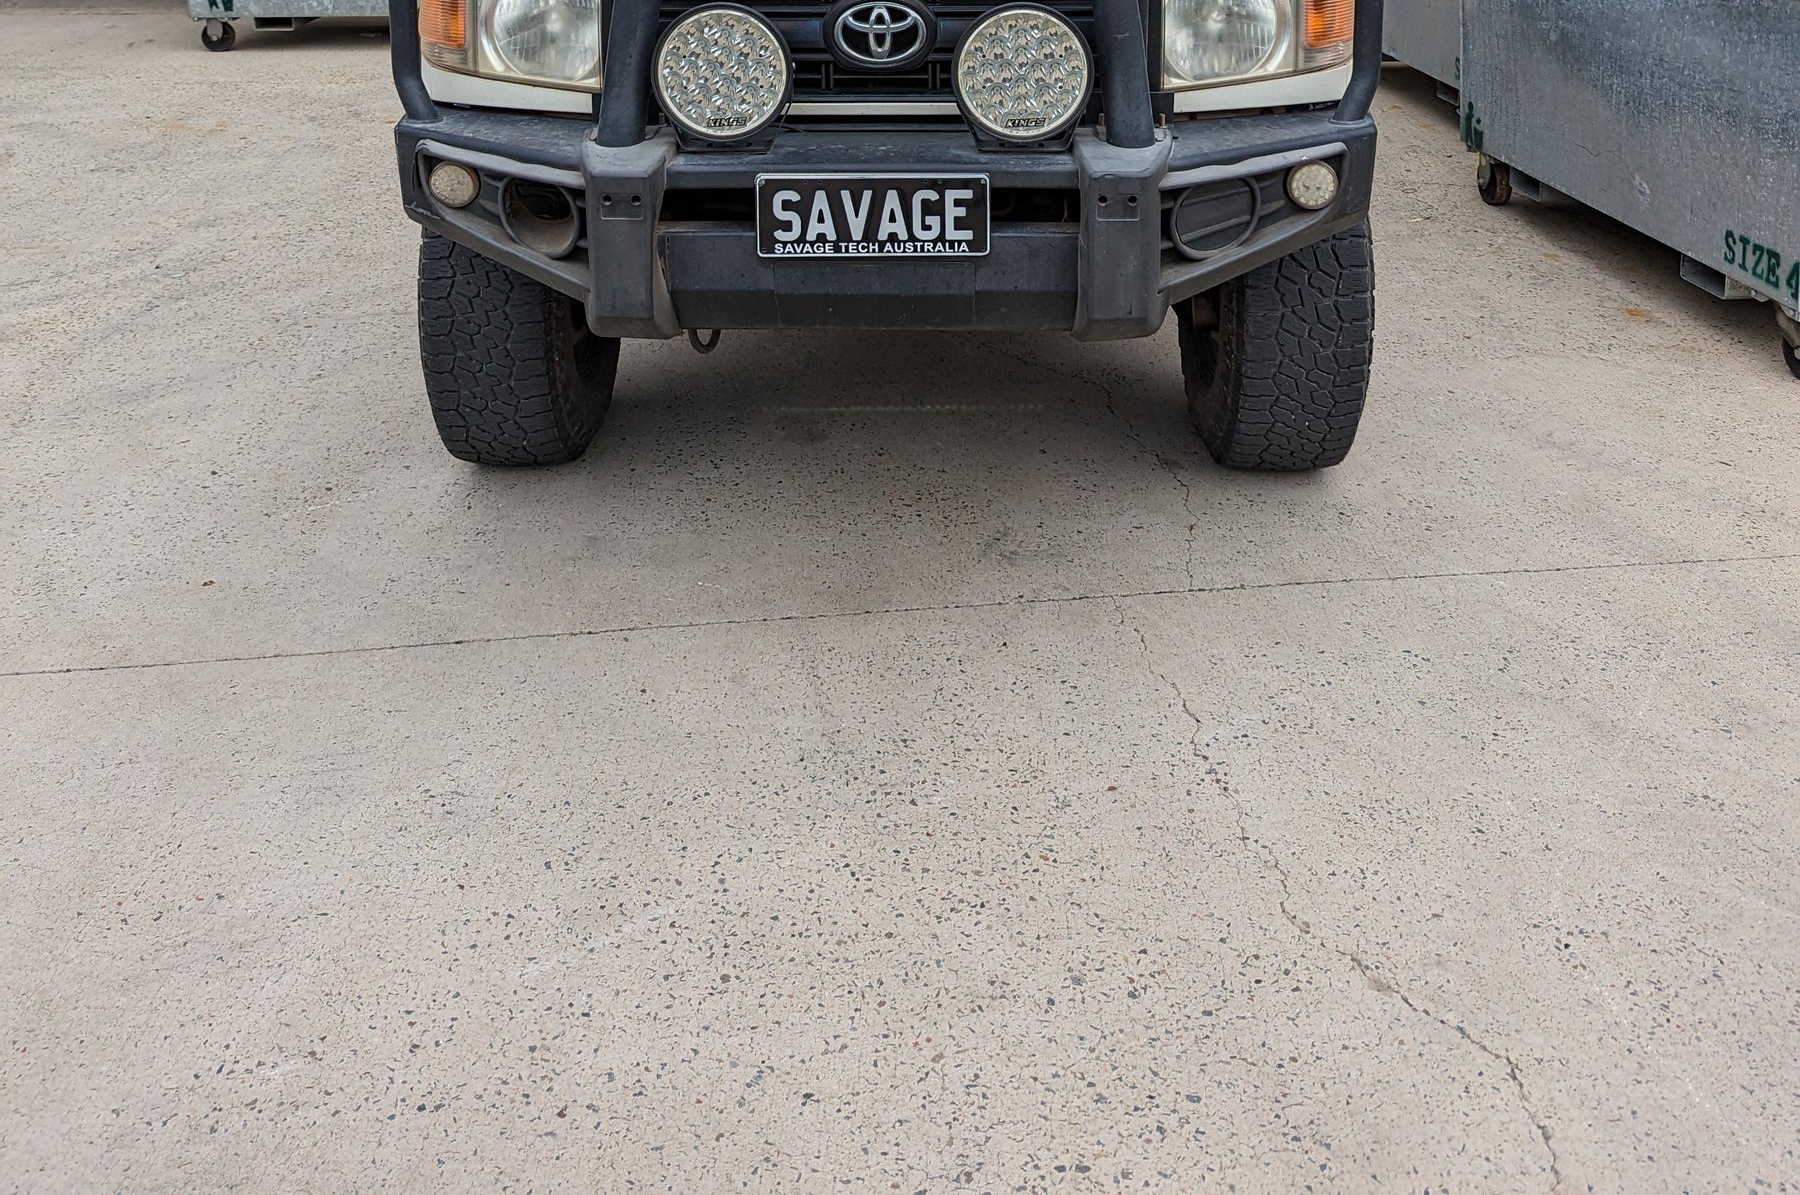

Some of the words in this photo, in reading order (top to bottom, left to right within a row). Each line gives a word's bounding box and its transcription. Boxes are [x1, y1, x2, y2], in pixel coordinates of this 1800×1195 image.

[706, 116, 748, 128] KINGS
[1005, 117, 1047, 128] KINGS
[772, 189, 974, 242] SAVAGE
[774, 242, 834, 253] SAVAGE
[839, 242, 879, 253] TECH
[883, 241, 969, 253] AUSTRALIA
[1723, 229, 1781, 289] SIZE
